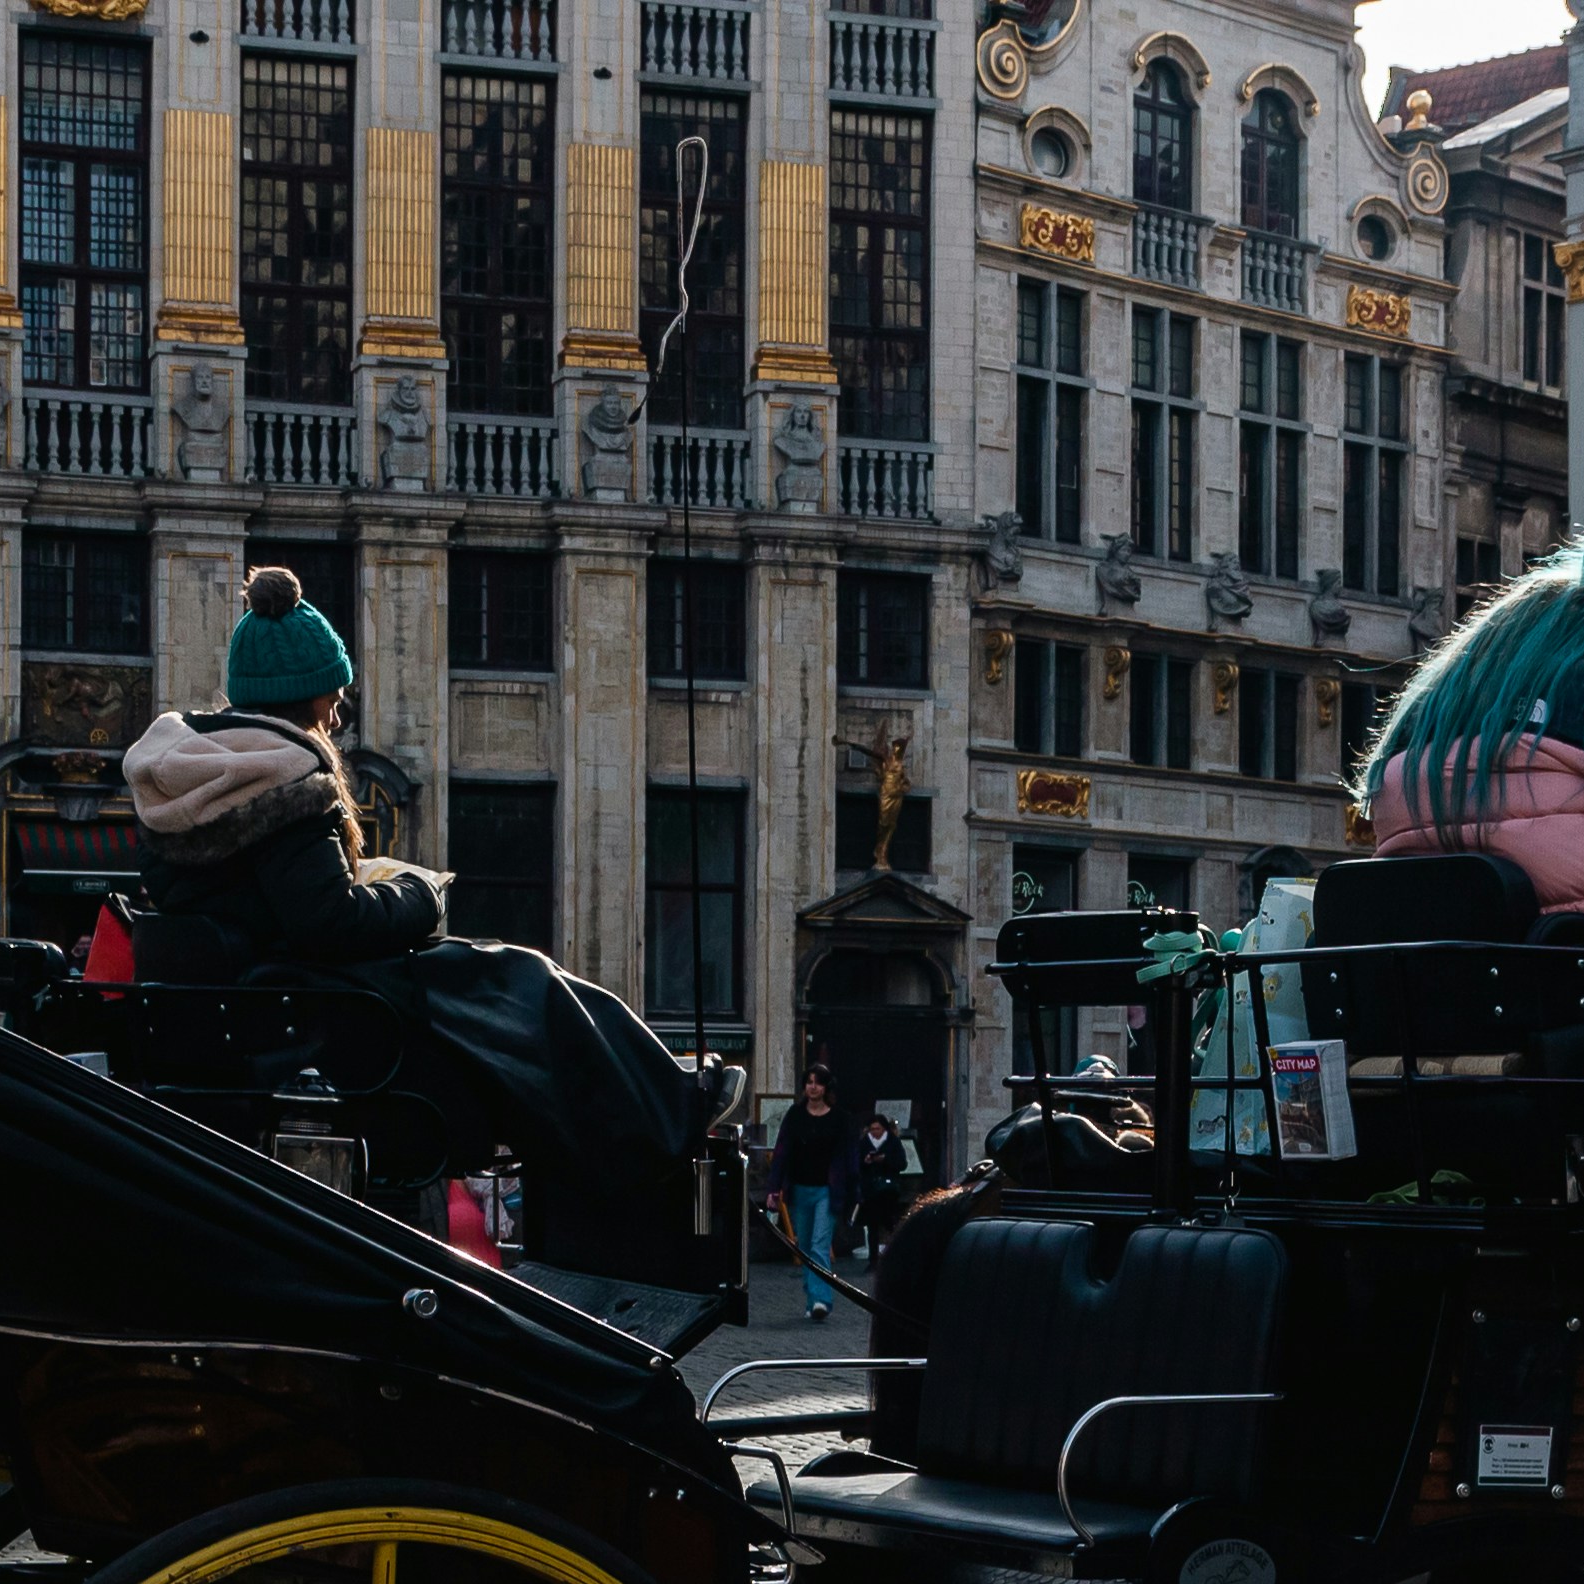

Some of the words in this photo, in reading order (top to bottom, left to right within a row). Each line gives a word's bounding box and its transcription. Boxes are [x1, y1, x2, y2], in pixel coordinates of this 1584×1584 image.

[1275, 1058, 1295, 1070] CITY
[1297, 1059, 1316, 1070] MAP
[1187, 1542, 1224, 1575] HERMAN
